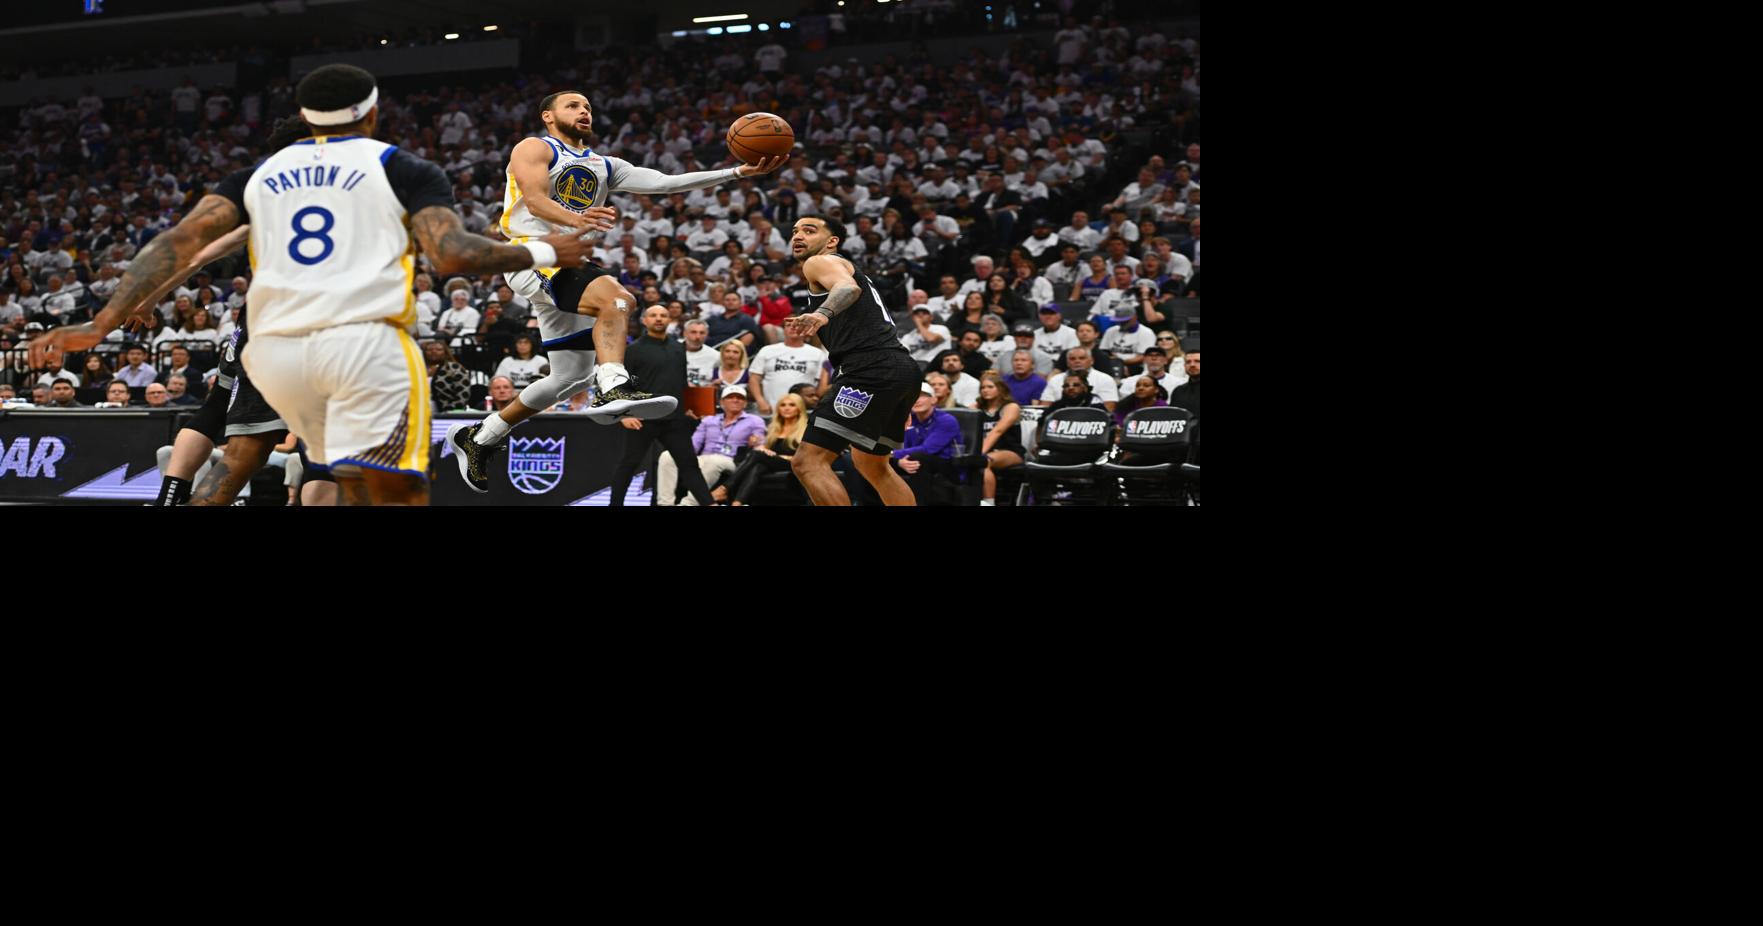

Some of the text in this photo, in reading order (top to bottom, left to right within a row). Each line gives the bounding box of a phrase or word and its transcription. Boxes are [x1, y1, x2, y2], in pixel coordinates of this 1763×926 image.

[264, 165, 341, 194] PAYTON
[580, 177, 594, 193] 30
[287, 205, 335, 265] 8
[836, 396, 866, 411] KINGS
[1056, 420, 1107, 435] PLAYOFFS
[1136, 420, 1187, 434] PLAYOFFS
[0, 436, 66, 478] AR
[511, 460, 561, 472] KINGS
